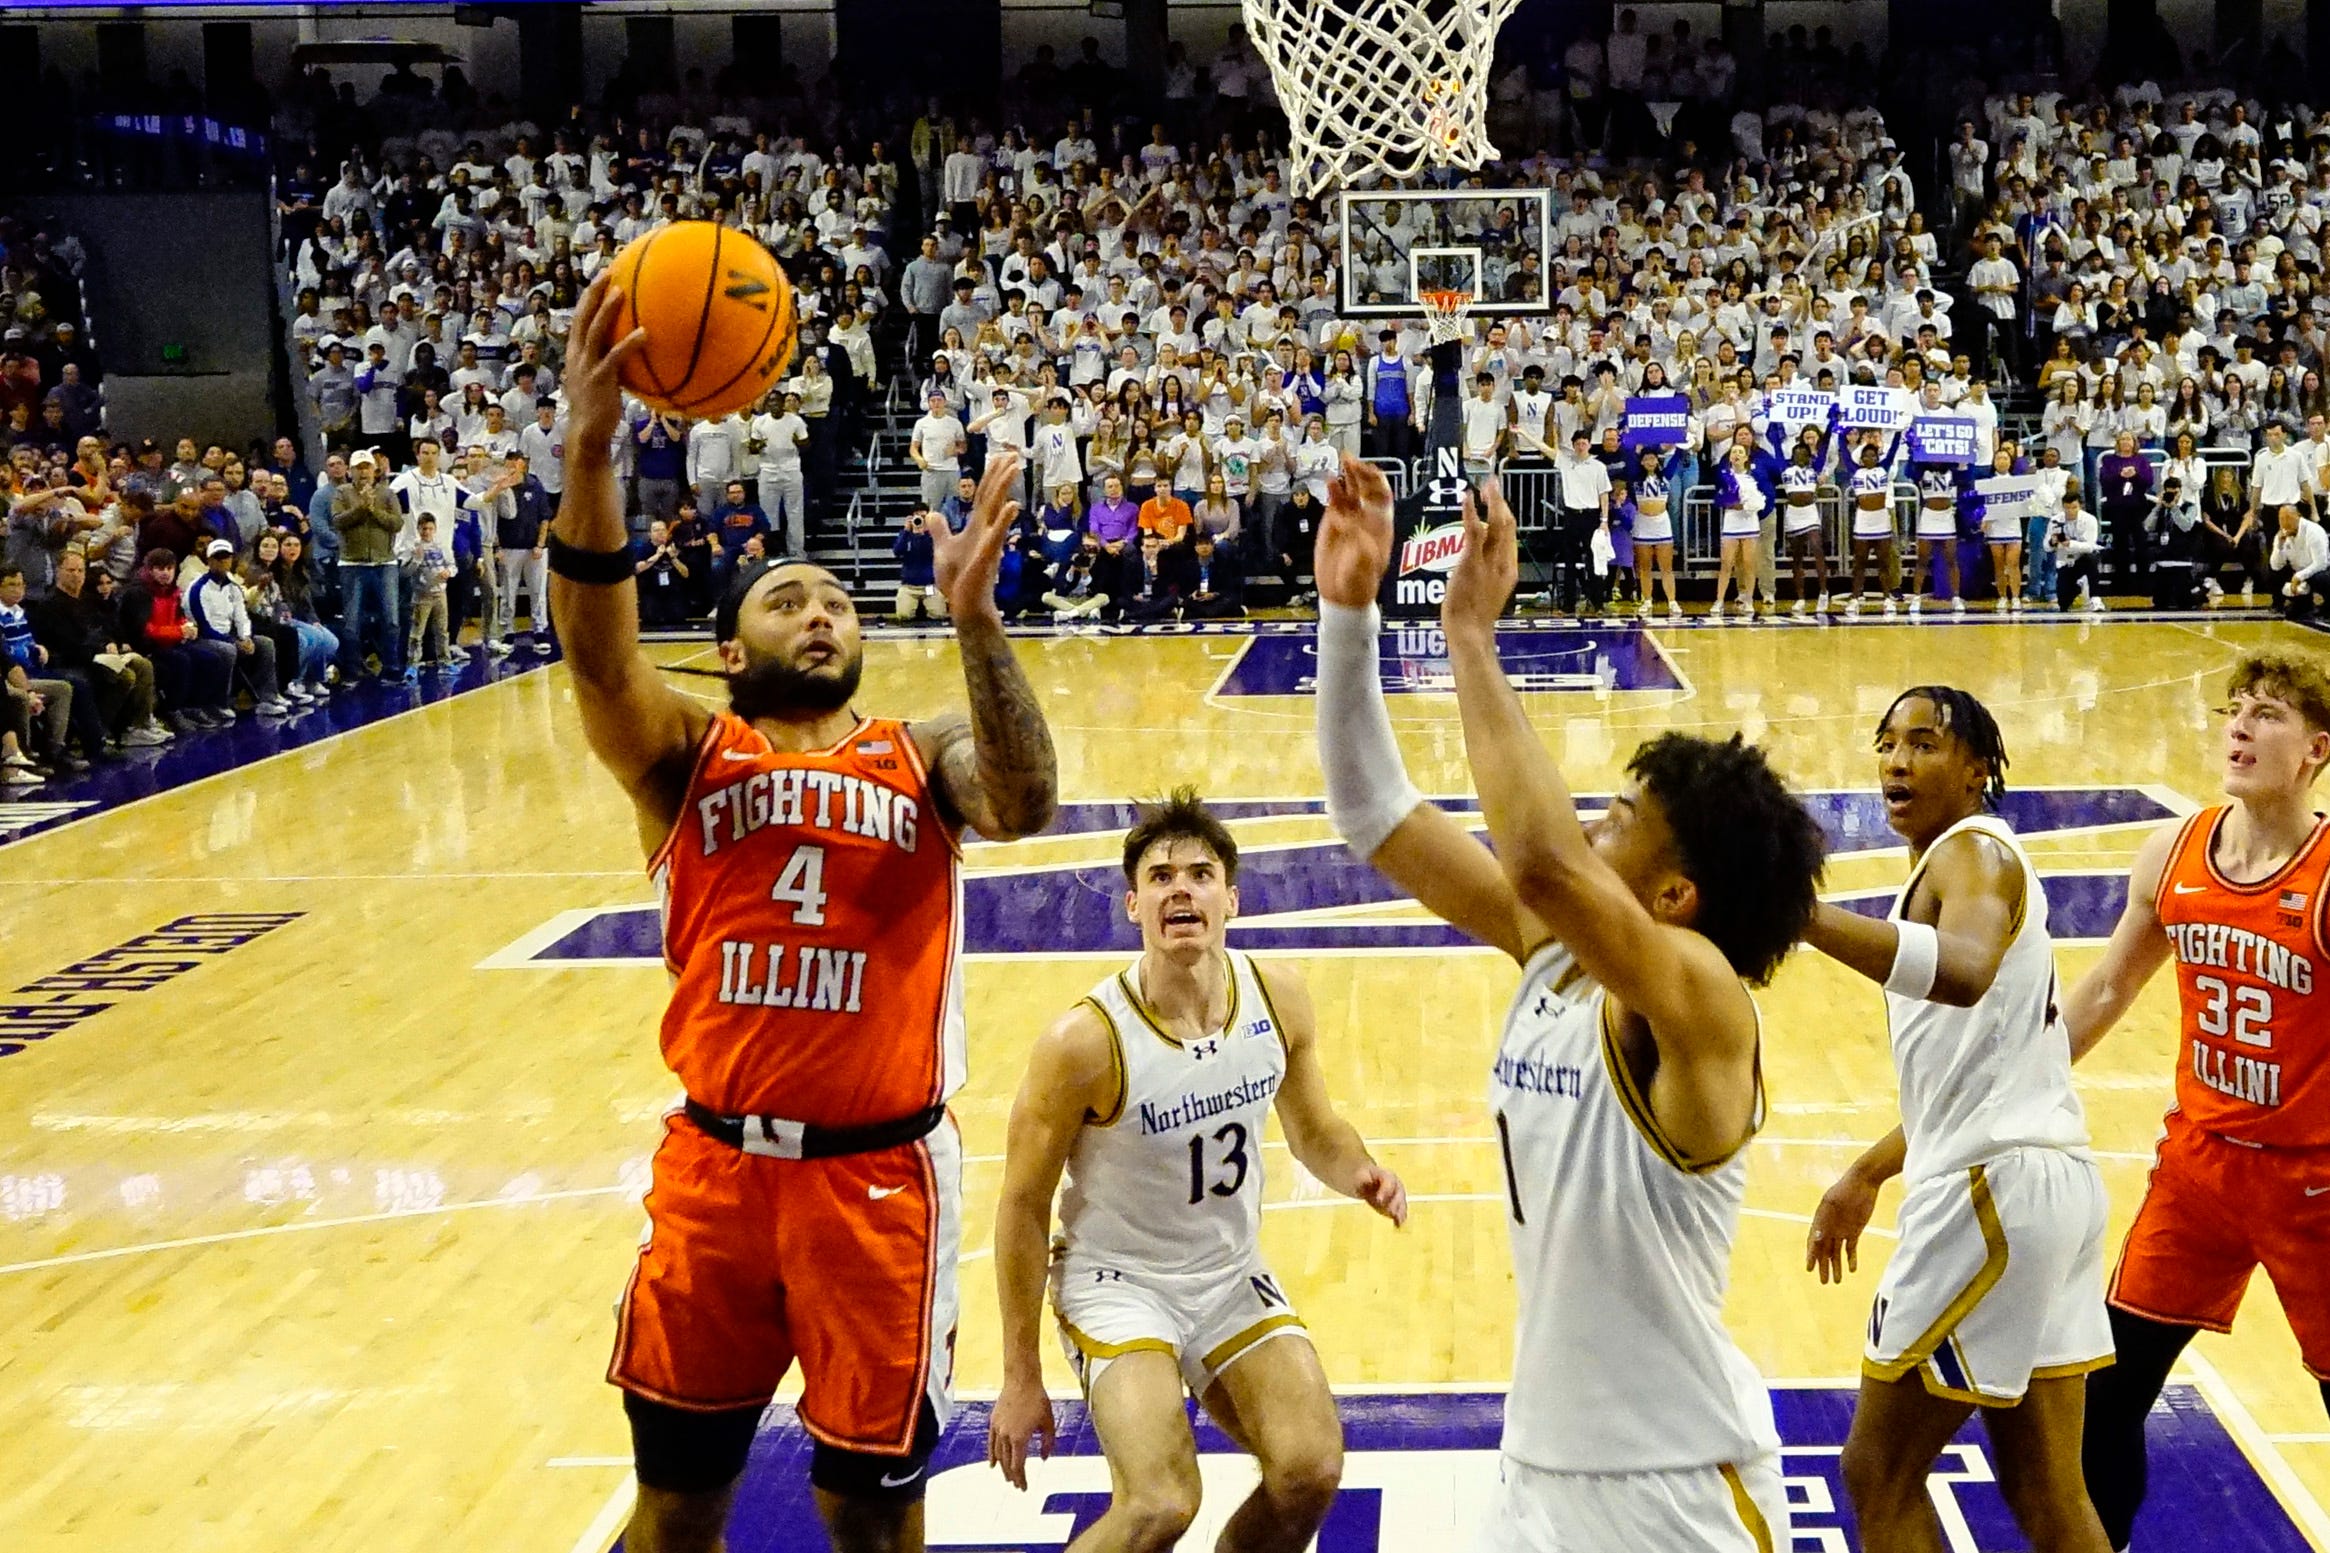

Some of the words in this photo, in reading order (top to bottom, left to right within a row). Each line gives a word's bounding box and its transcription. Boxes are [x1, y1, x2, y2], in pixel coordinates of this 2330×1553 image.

[1775, 392, 1831, 405] STAND
[1854, 389, 1889, 405] GET
[1527, 402, 1538, 418] N
[1786, 406, 1818, 420] UP!
[1844, 407, 1899, 425] LOUD!
[1627, 413, 1687, 428] DEFENSE
[1916, 423, 1955, 439] LET'S
[1956, 424, 1974, 439] GO
[1052, 433, 1063, 449] N
[1922, 438, 1970, 455] 'CATS!
[1438, 446, 1458, 478] N
[1794, 470, 1808, 486] N
[1866, 473, 1880, 490] N
[1933, 476, 1947, 492] N
[1645, 480, 1659, 498] N
[1984, 489, 2035, 504] EFENSE
[698, 769, 918, 856] FIGHTING
[772, 845, 827, 926] 4
[2165, 923, 2312, 995] FIGHTING
[718, 941, 867, 1013] ILLINI
[2196, 975, 2272, 1048] 32
[2193, 1039, 2281, 1106] ILLINI
[1141, 1074, 1277, 1136] Northwestern
[1188, 1122, 1248, 1205] 13
[1496, 1107, 1525, 1226] 1
[1250, 1273, 1288, 1308] N
